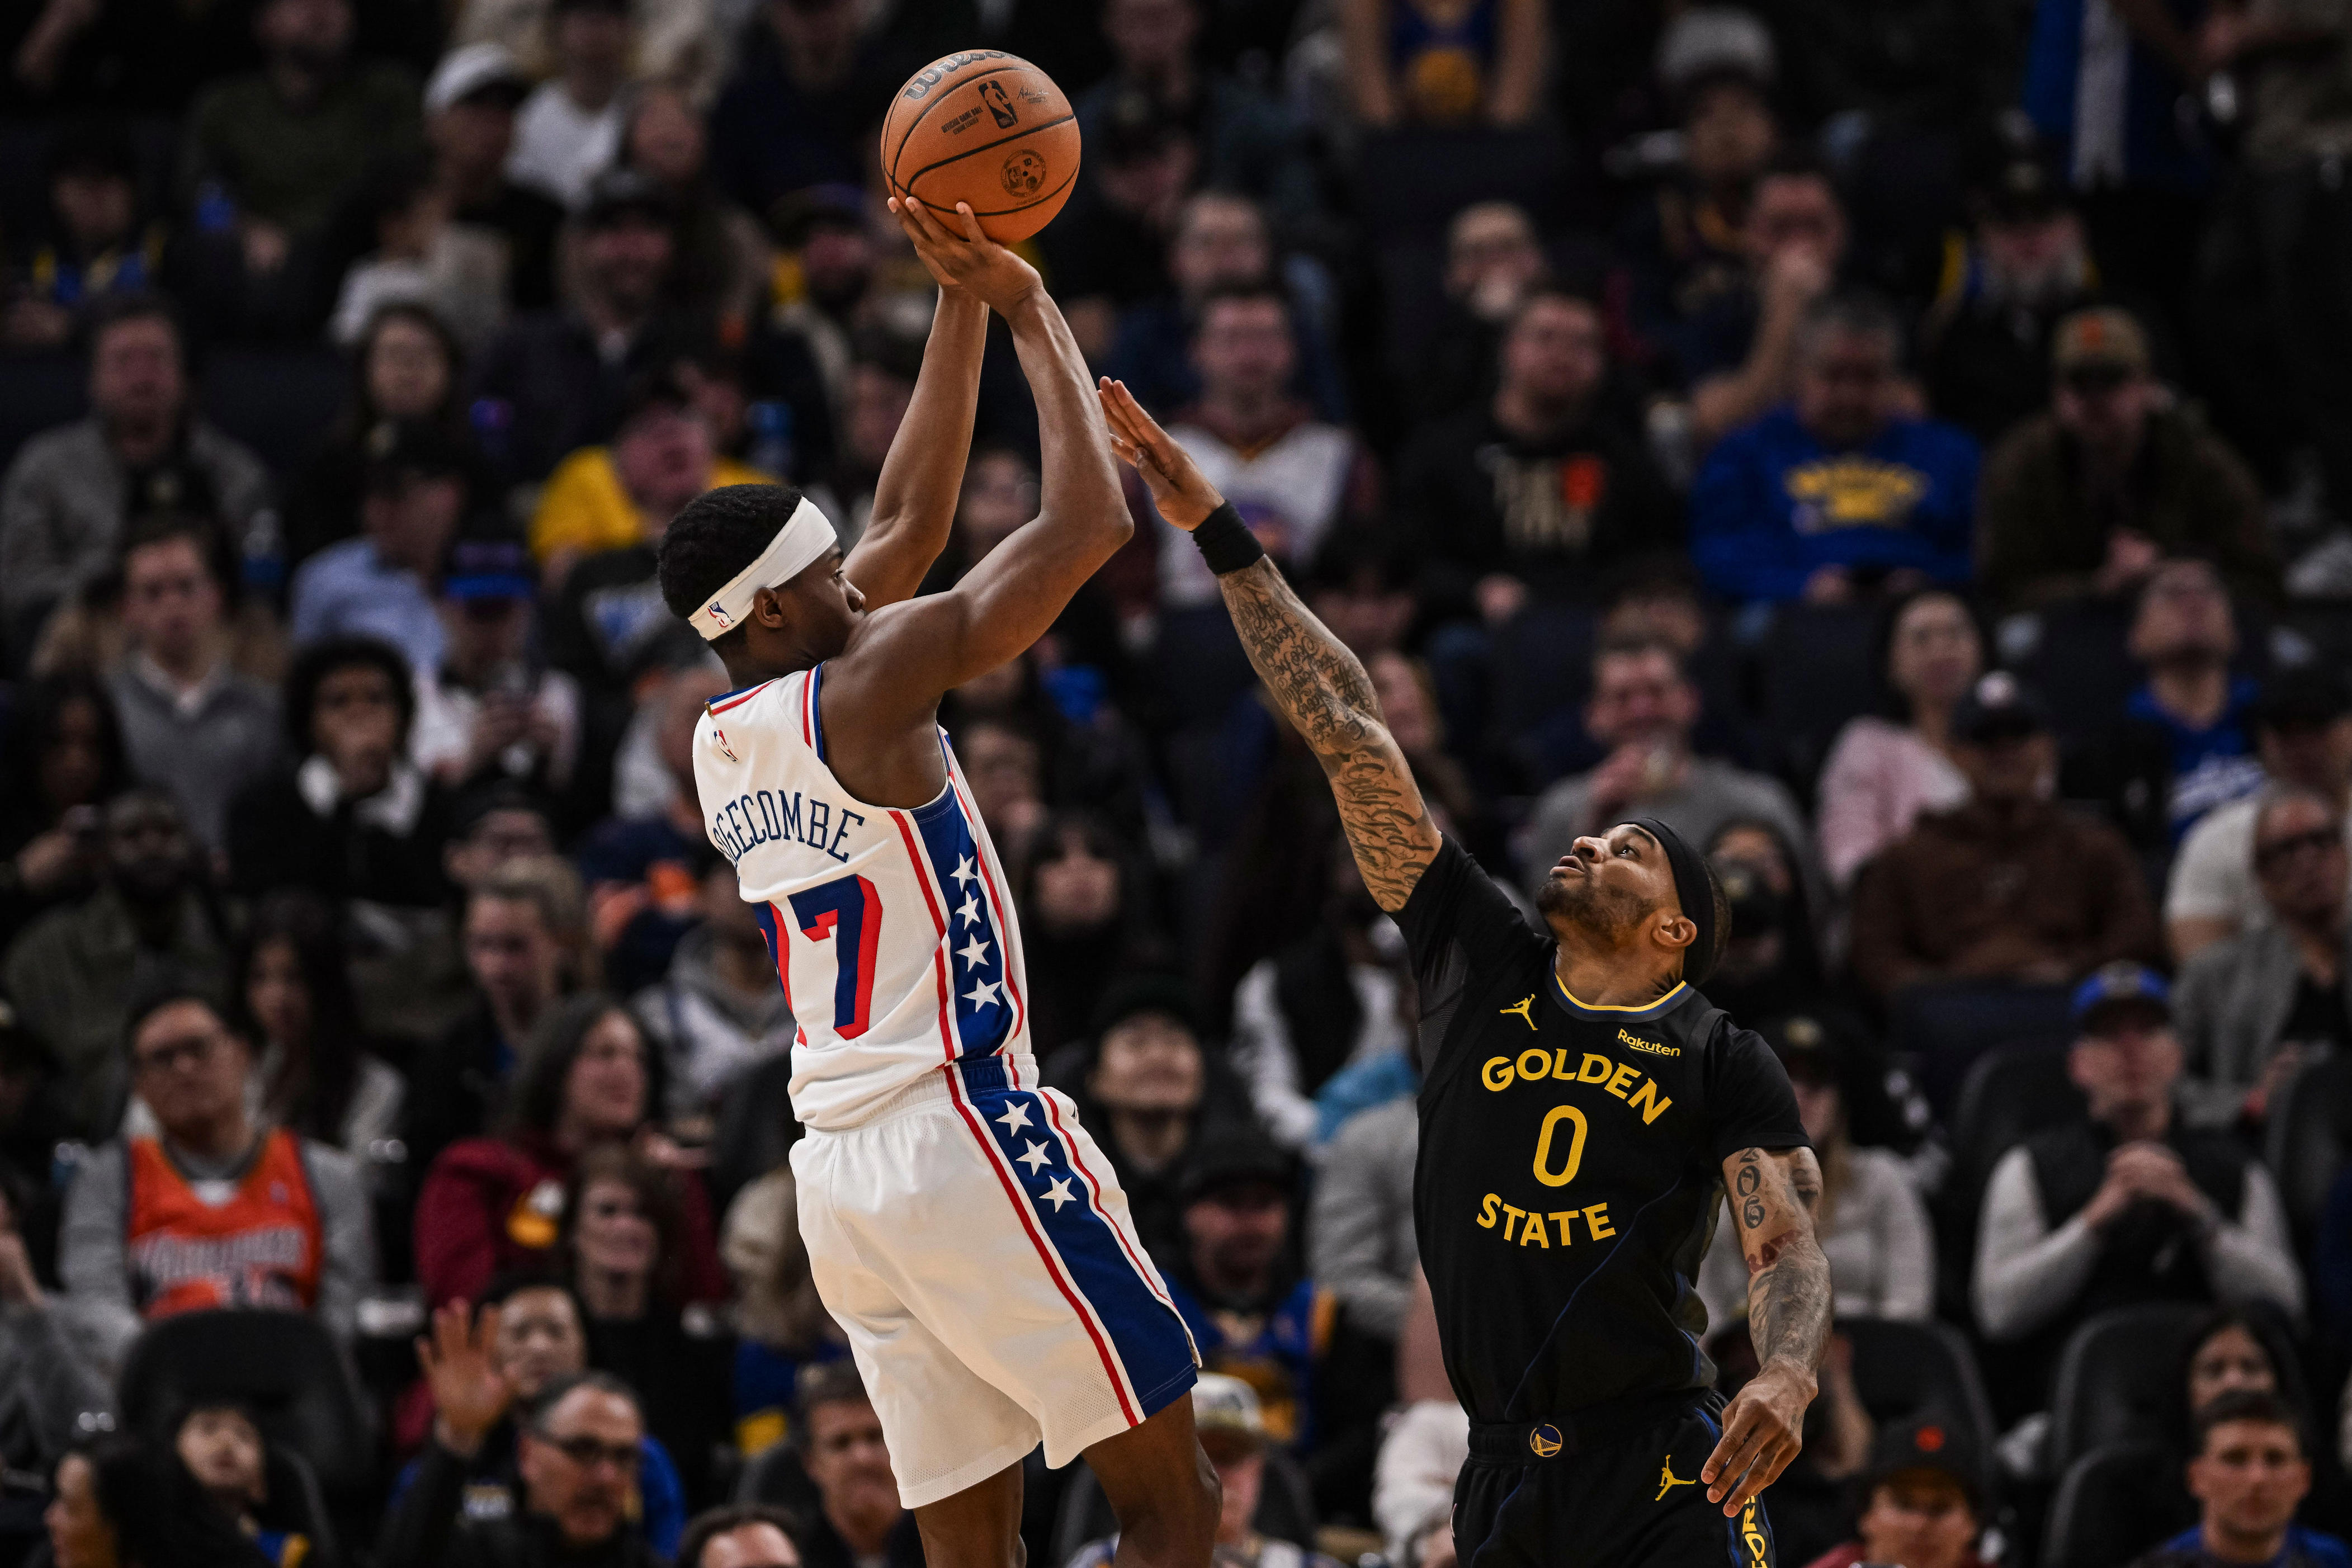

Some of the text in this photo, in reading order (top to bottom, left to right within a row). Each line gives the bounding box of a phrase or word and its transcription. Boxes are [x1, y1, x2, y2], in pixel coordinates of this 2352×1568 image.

[713, 789, 865, 872] DGECOMBE
[1617, 1028, 1680, 1057] Rakuten
[1481, 1049, 1673, 1125] GOLDEN
[1533, 1105, 1588, 1187] 0
[1476, 1193, 1616, 1248] STATE
